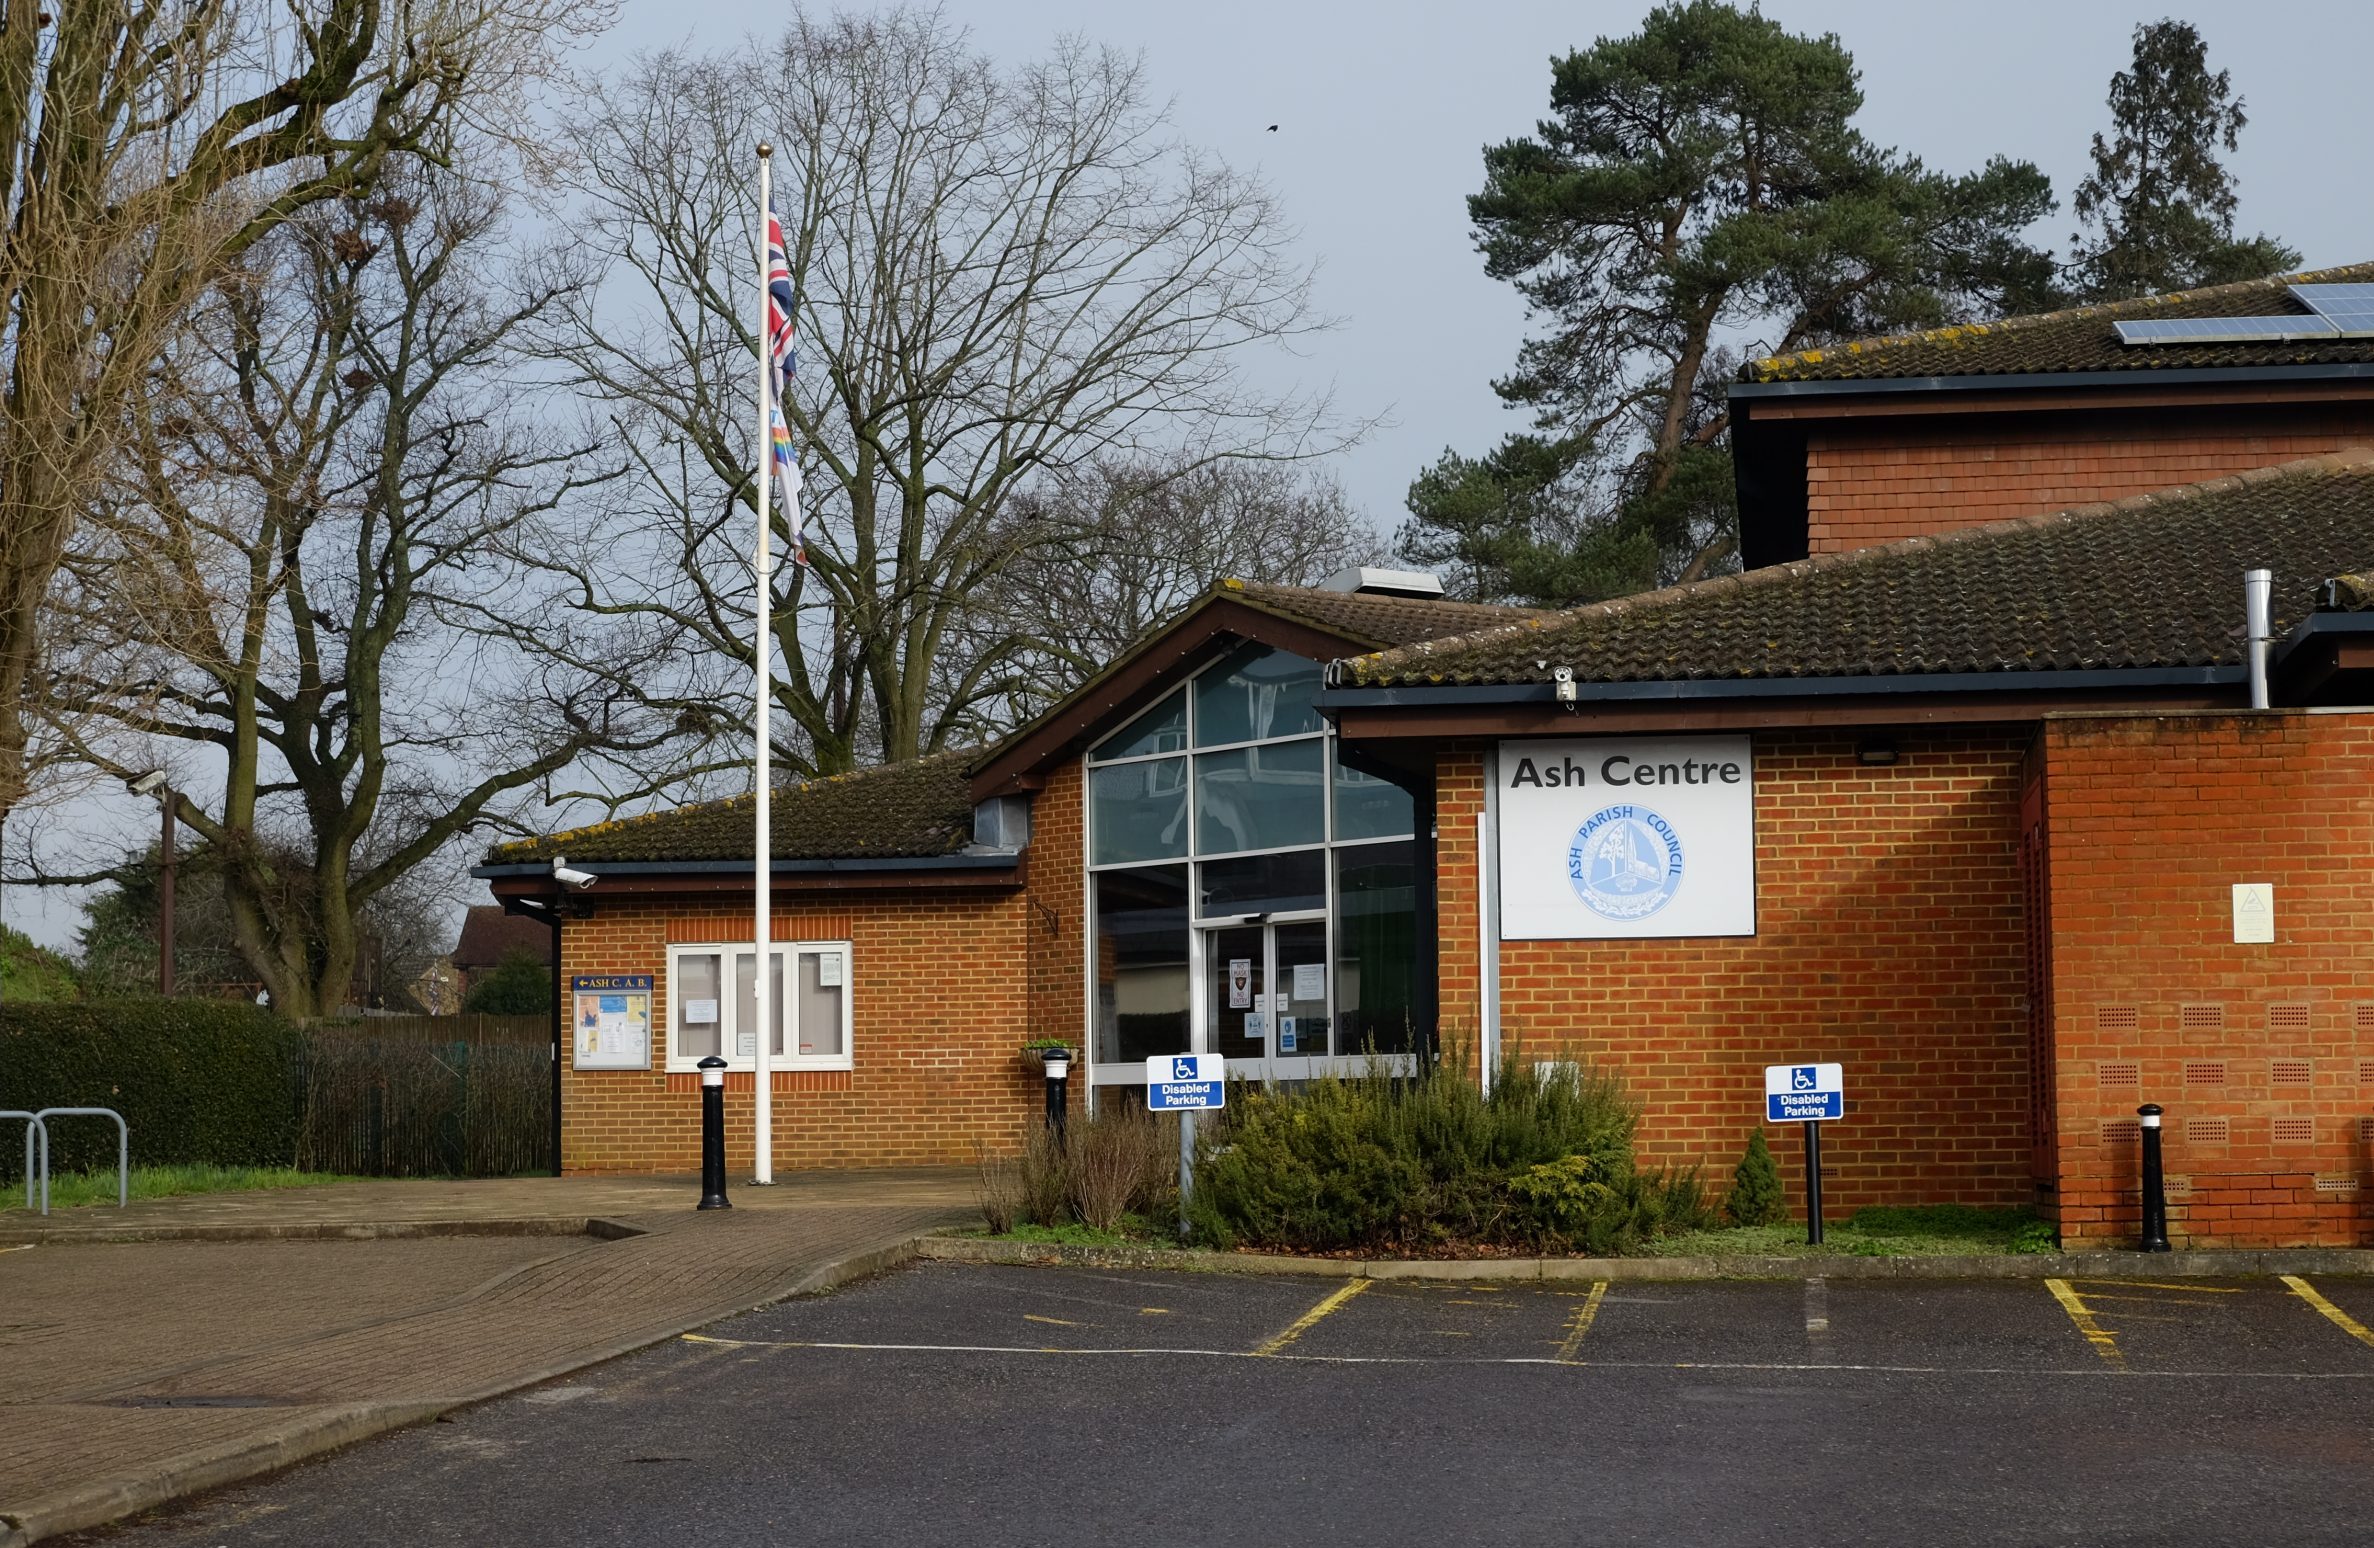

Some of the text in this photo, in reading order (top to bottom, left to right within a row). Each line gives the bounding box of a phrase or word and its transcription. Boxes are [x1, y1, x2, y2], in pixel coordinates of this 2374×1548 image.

[1510, 755, 1741, 788] Ash Centre
[1569, 806, 1682, 879] ASH PARISH COUNCIL
[589, 978, 609, 988] ASH
[1162, 1083, 1210, 1094] Disabled
[1165, 1094, 1207, 1106] Parking
[1780, 1094, 1829, 1105] Disabled
[1784, 1105, 1825, 1117] Parking
